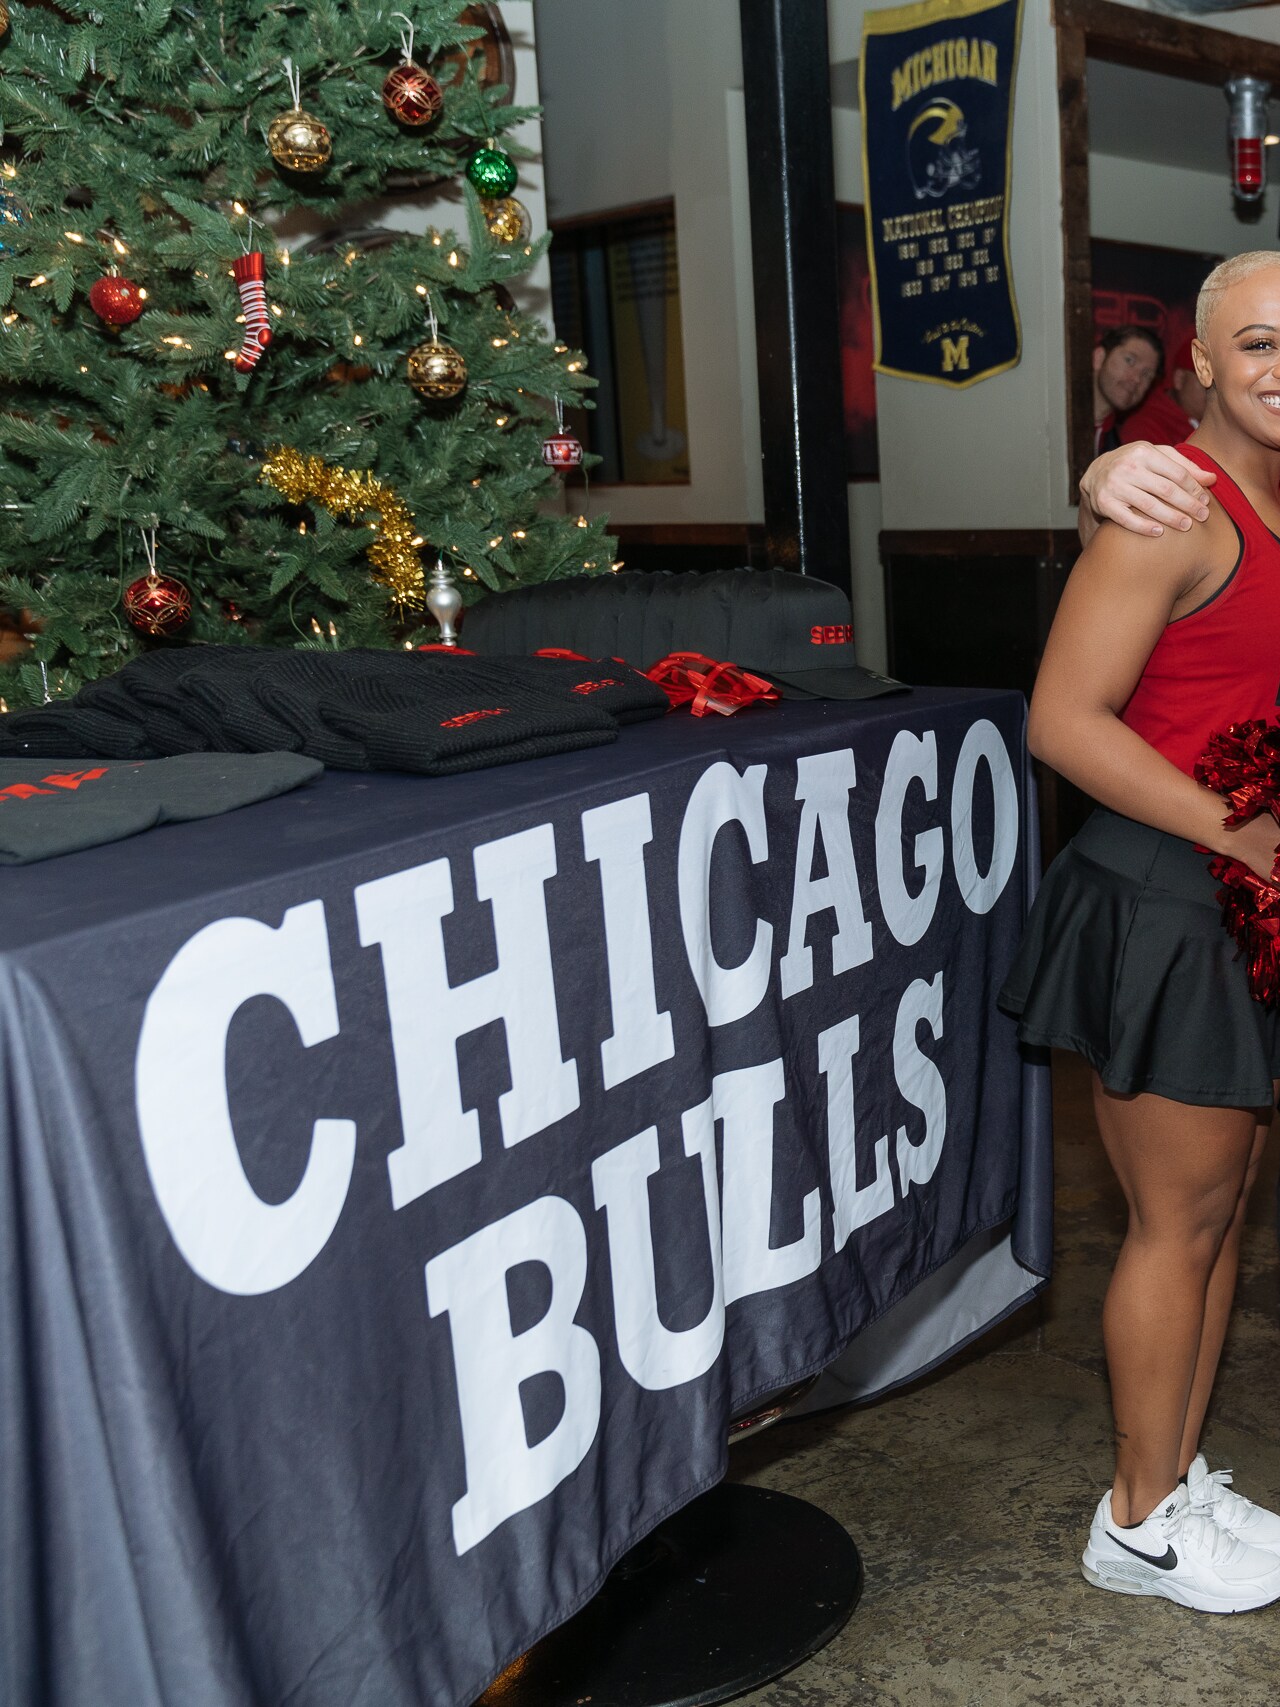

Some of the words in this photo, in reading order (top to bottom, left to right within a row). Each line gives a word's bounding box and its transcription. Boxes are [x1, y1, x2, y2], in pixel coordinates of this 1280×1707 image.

[892, 37, 998, 111] MICHIGAN
[941, 335, 969, 371] M
[135, 719, 1019, 1295] CHICAGO
[425, 971, 947, 1556] BULLS
